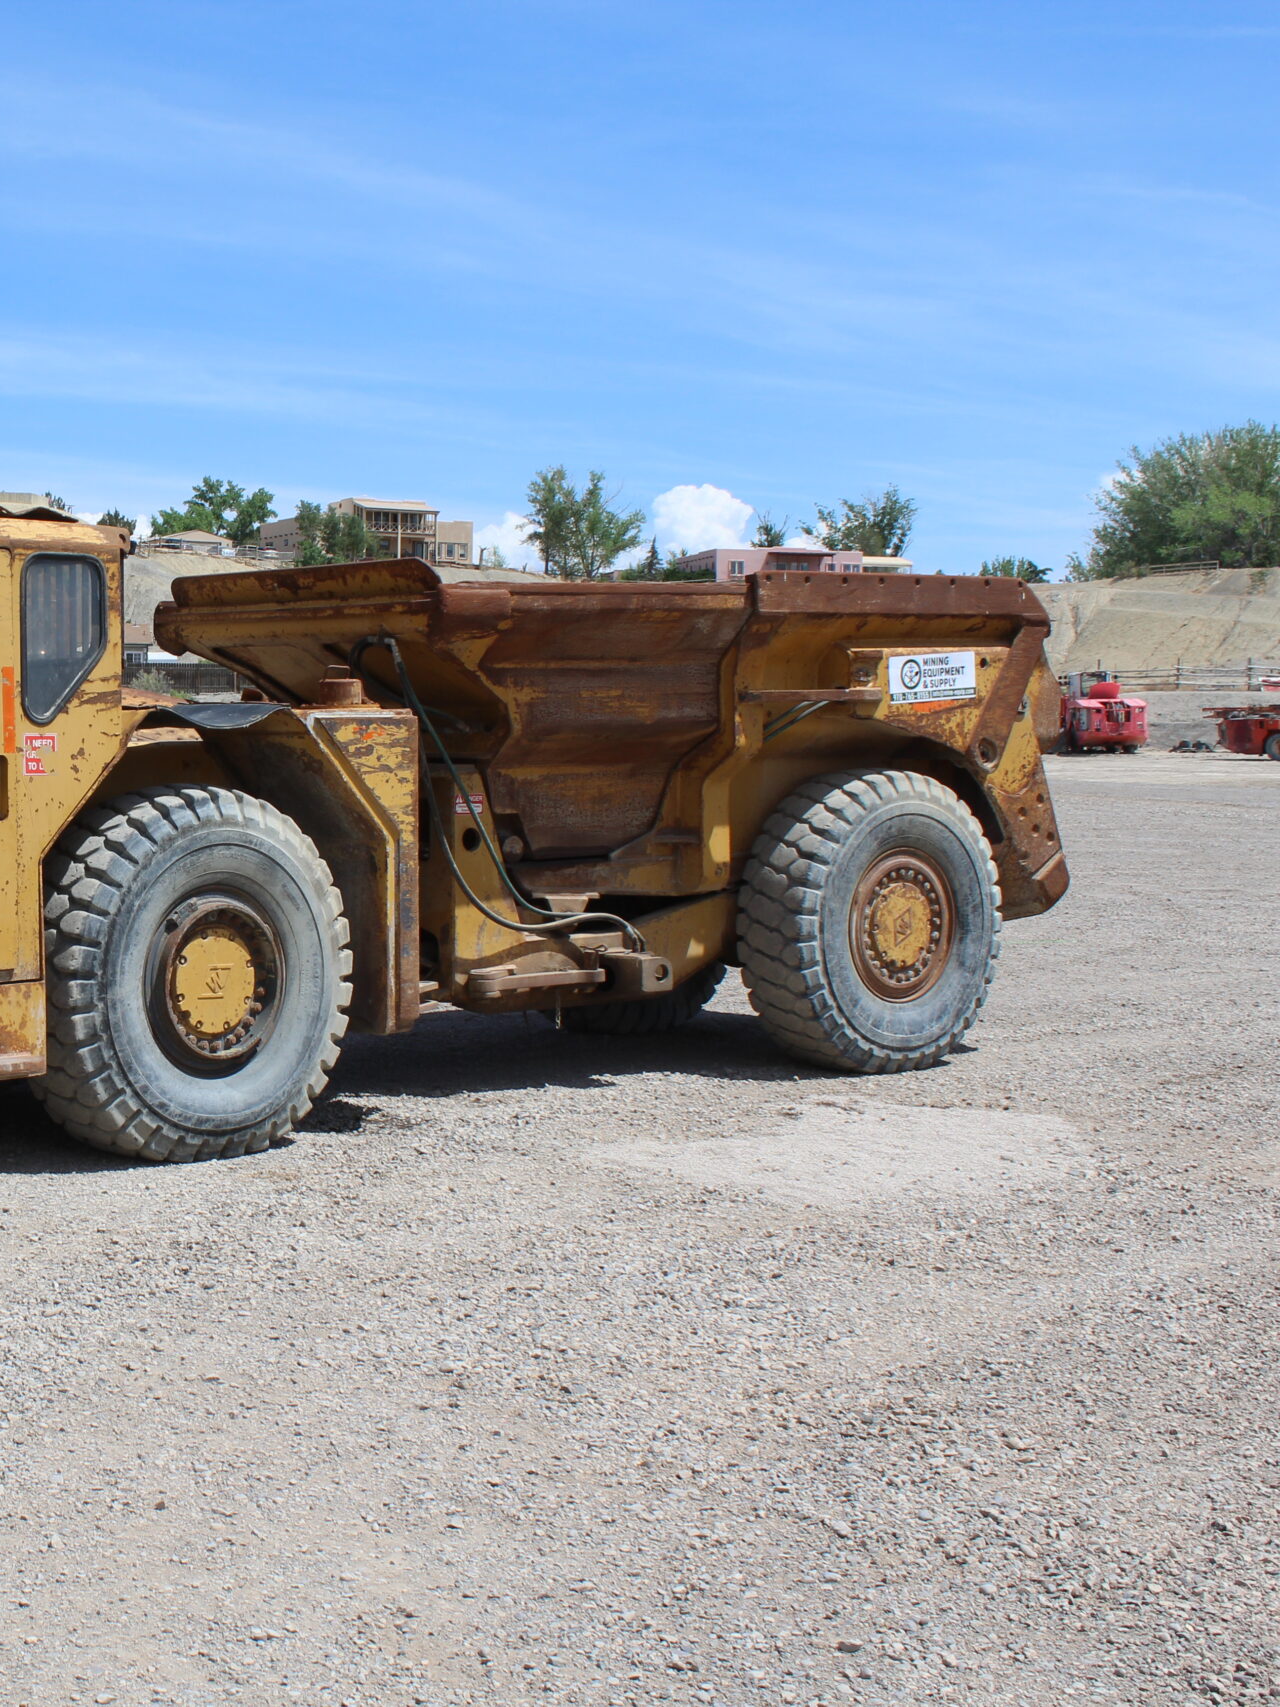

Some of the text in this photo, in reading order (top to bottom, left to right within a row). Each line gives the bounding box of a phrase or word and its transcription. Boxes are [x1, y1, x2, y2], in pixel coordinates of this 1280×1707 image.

[922, 656, 949, 667] MINING
[922, 666, 965, 678] EQUIPMENT
[922, 677, 956, 688] & SUPPLY
[32, 739, 53, 748] NEED
[27, 762, 37, 771] TO
